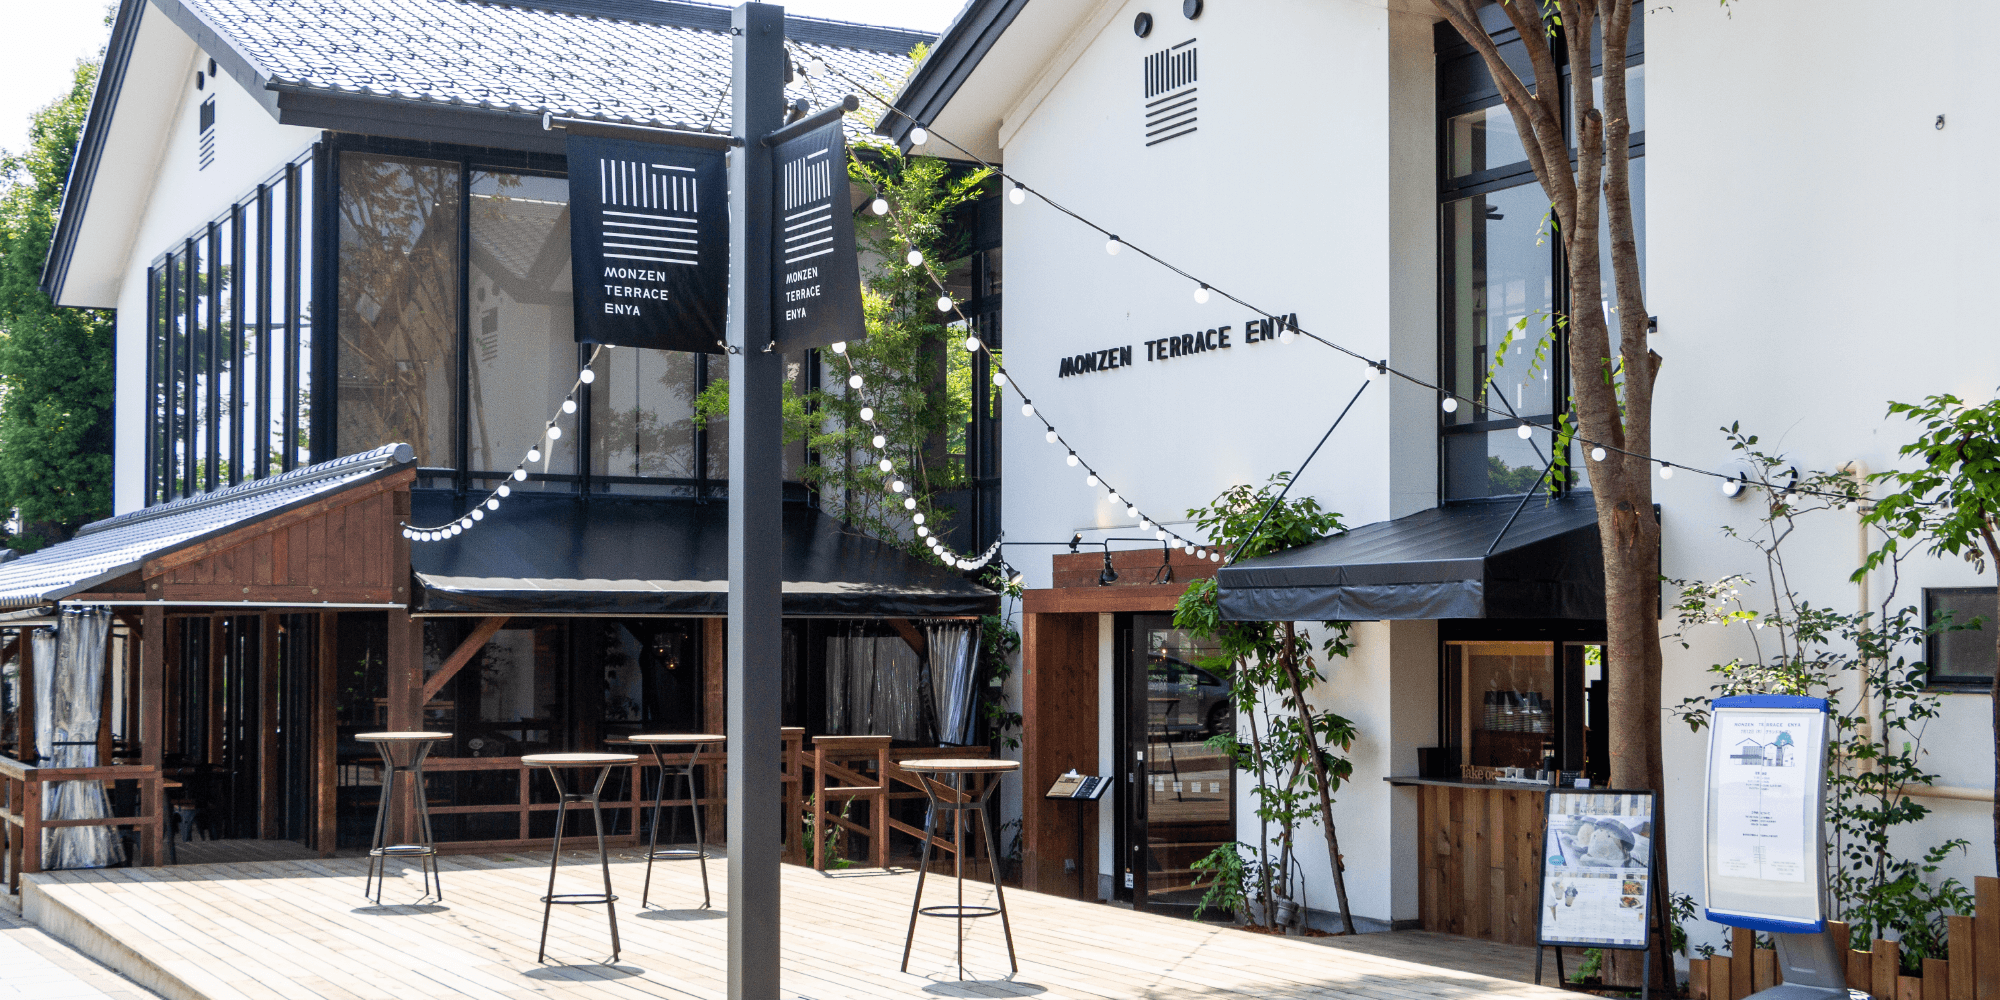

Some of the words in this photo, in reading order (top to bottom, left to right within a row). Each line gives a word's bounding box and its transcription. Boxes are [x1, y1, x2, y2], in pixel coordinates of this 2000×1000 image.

[604, 266, 666, 282] MONZEN
[785, 266, 818, 285] MONZEN
[604, 284, 669, 301] TERRACE
[785, 285, 821, 303] TERRACE
[604, 303, 641, 317] ENYA
[785, 307, 807, 321] ENYA
[1058, 345, 1132, 378] MONZEN
[1144, 325, 1232, 362] TERRACE
[1245, 312, 1300, 344] ENYA
[1460, 764, 1484, 779] Take
